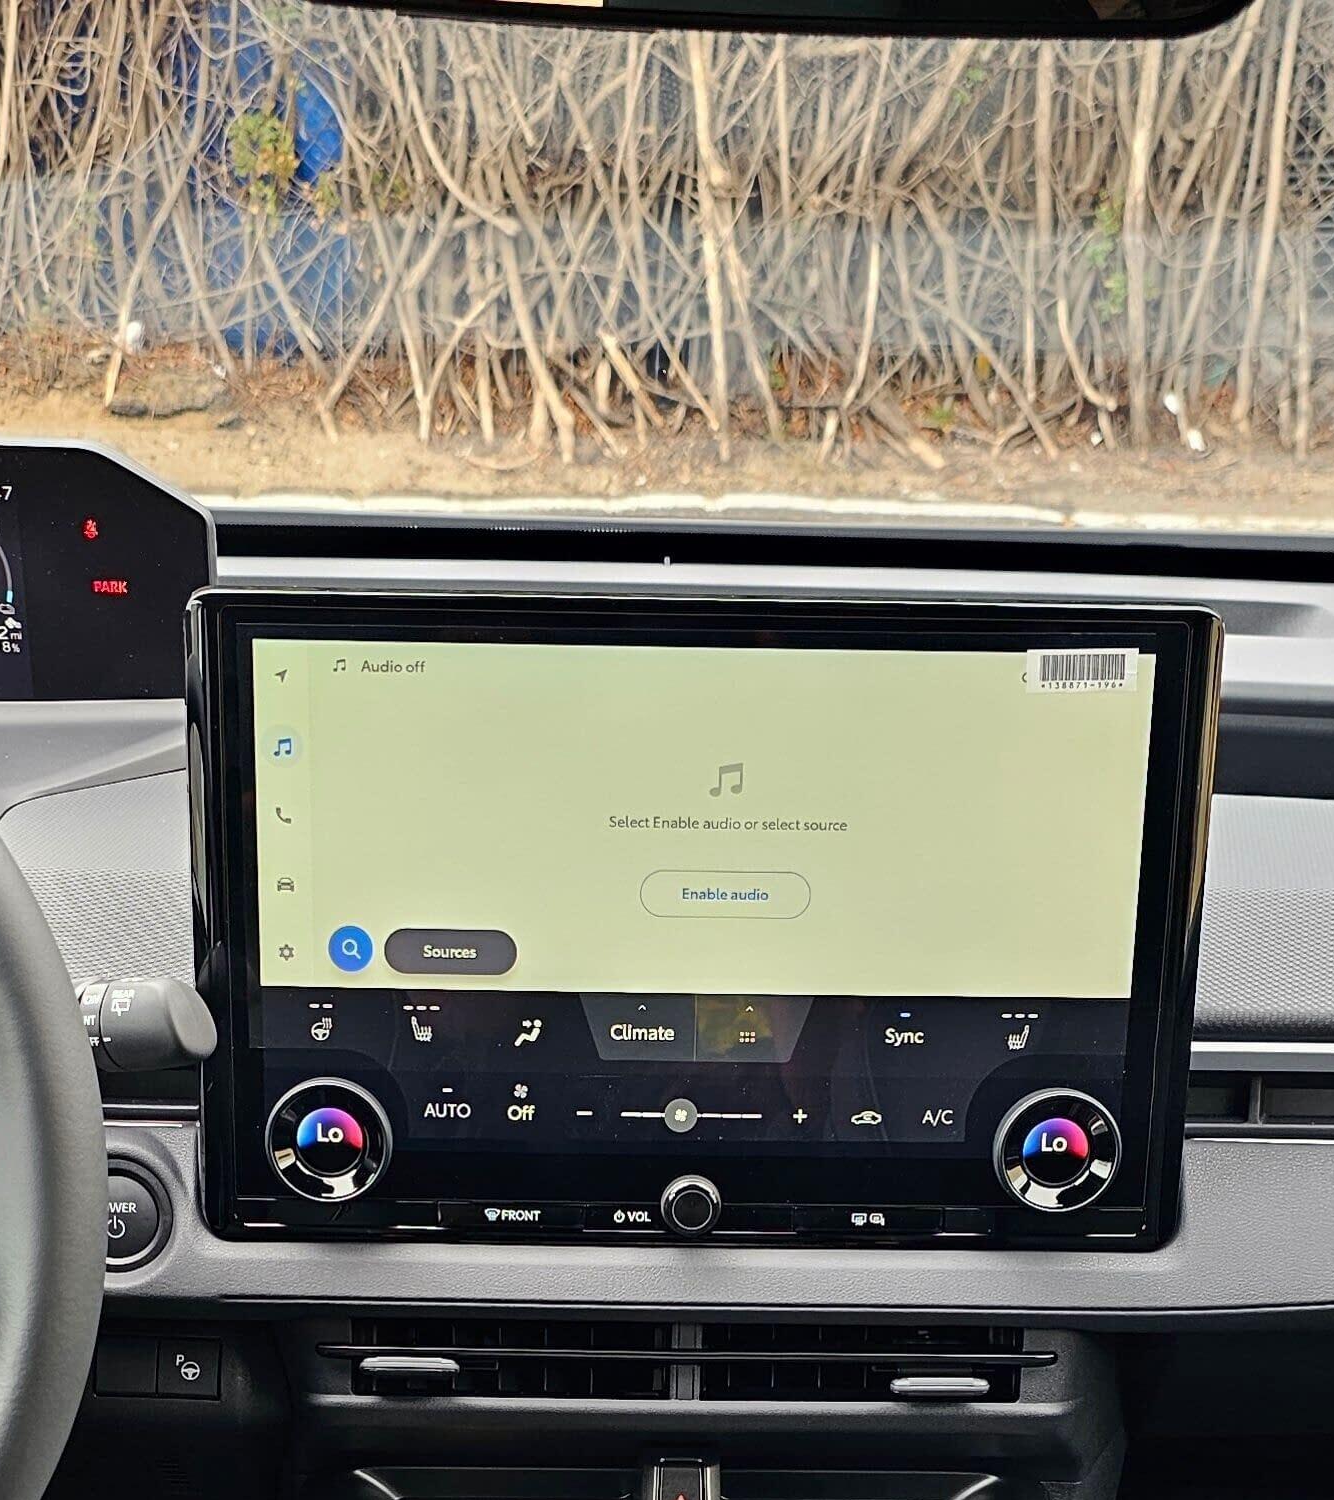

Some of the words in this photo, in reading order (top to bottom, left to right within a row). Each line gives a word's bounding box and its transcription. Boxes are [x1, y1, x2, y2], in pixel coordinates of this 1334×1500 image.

[93, 580, 128, 594] PARK
[361, 660, 403, 673] Audio
[405, 660, 426, 673] off
[609, 816, 650, 829] Select
[653, 816, 700, 830] Enable
[702, 817, 741, 830] audio
[743, 820, 759, 830] or
[761, 817, 801, 831] select
[803, 821, 848, 832] source
[682, 887, 728, 901] Enable
[730, 889, 769, 901] audio
[423, 944, 478, 960] Sources
[610, 1024, 676, 1042] Climate
[884, 1027, 925, 1047] Sync
[424, 1103, 472, 1119] AUTO
[506, 1104, 536, 1121] Off
[921, 1109, 954, 1127] A/C
[316, 1122, 344, 1143] Lo
[1041, 1132, 1068, 1153] Lo
[108, 1202, 138, 1214] WER
[501, 1209, 541, 1222] FRONT
[627, 1210, 652, 1223] VOL
